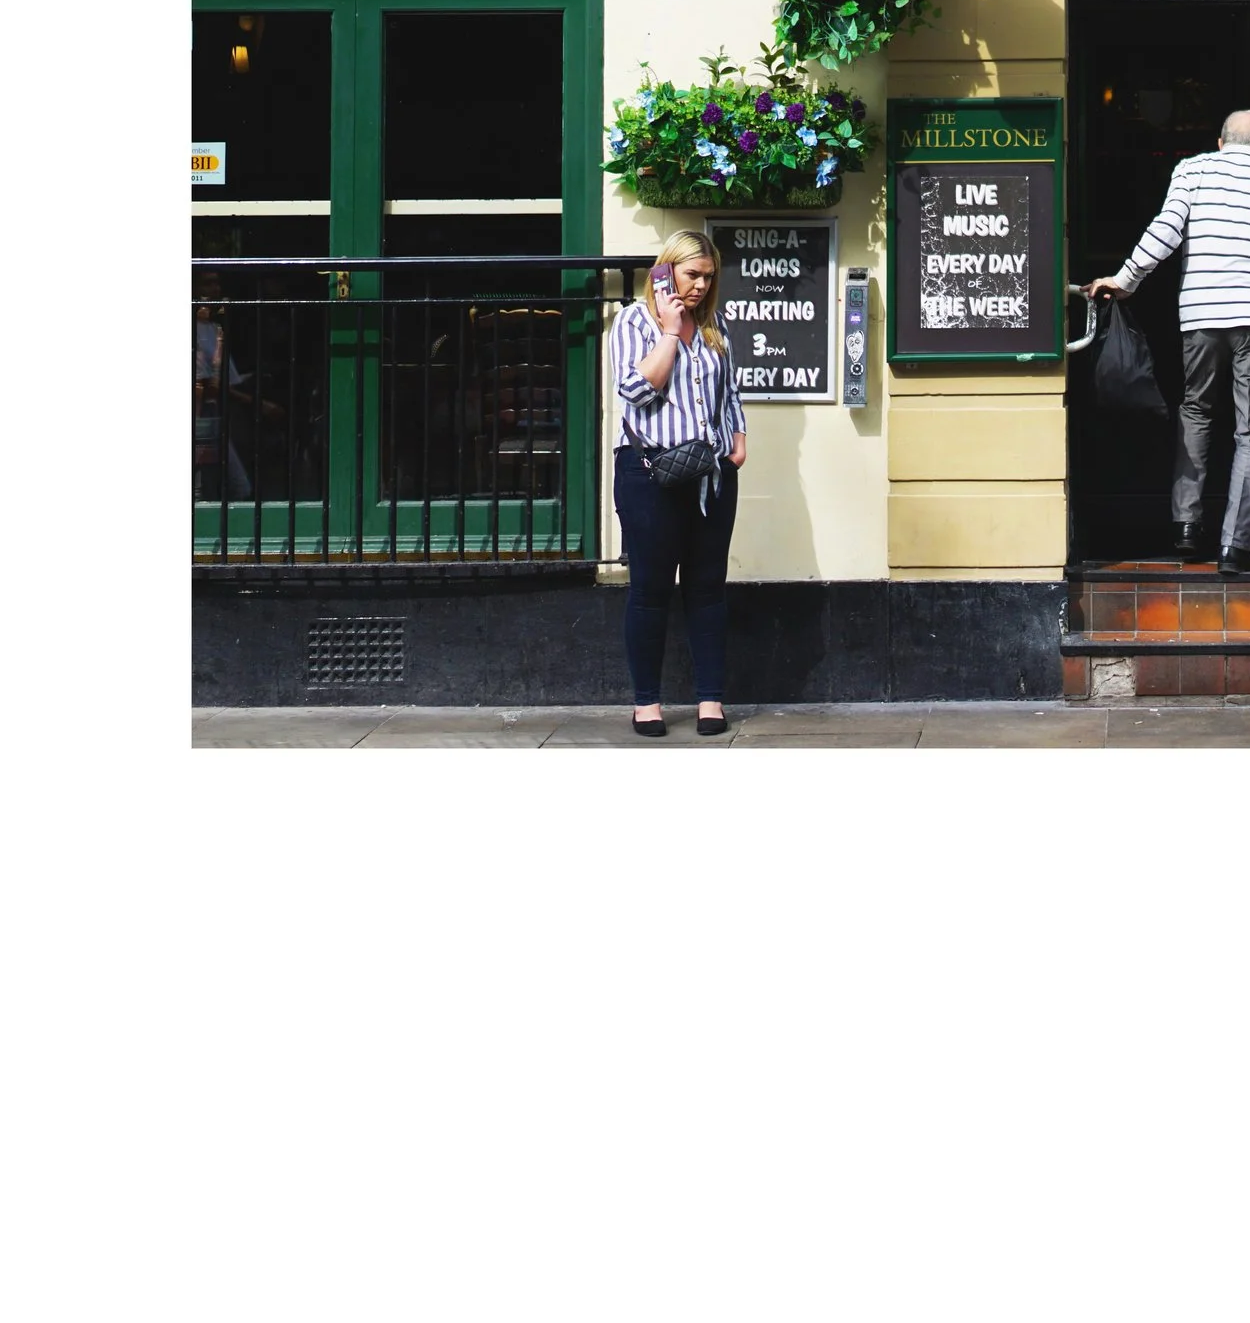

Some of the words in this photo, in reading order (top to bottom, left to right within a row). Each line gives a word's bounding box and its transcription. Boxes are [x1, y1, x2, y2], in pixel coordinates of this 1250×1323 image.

[923, 113, 956, 125] THE
[901, 128, 1048, 148] MILLSTONE
[955, 184, 998, 206] LIVE
[943, 214, 1010, 237] MUSIC
[734, 228, 807, 249] SING-A-
[741, 258, 800, 278] LONGS
[927, 254, 985, 274] EVERY
[989, 254, 1027, 274] DAY
[755, 285, 784, 293] NOW
[967, 280, 983, 288] OF
[724, 300, 815, 322] STARTING
[925, 296, 966, 317] THE
[969, 296, 1024, 317] WEEK
[753, 333, 786, 356] 3PM
[736, 367, 778, 387] VERY
[783, 367, 820, 387] DAY
